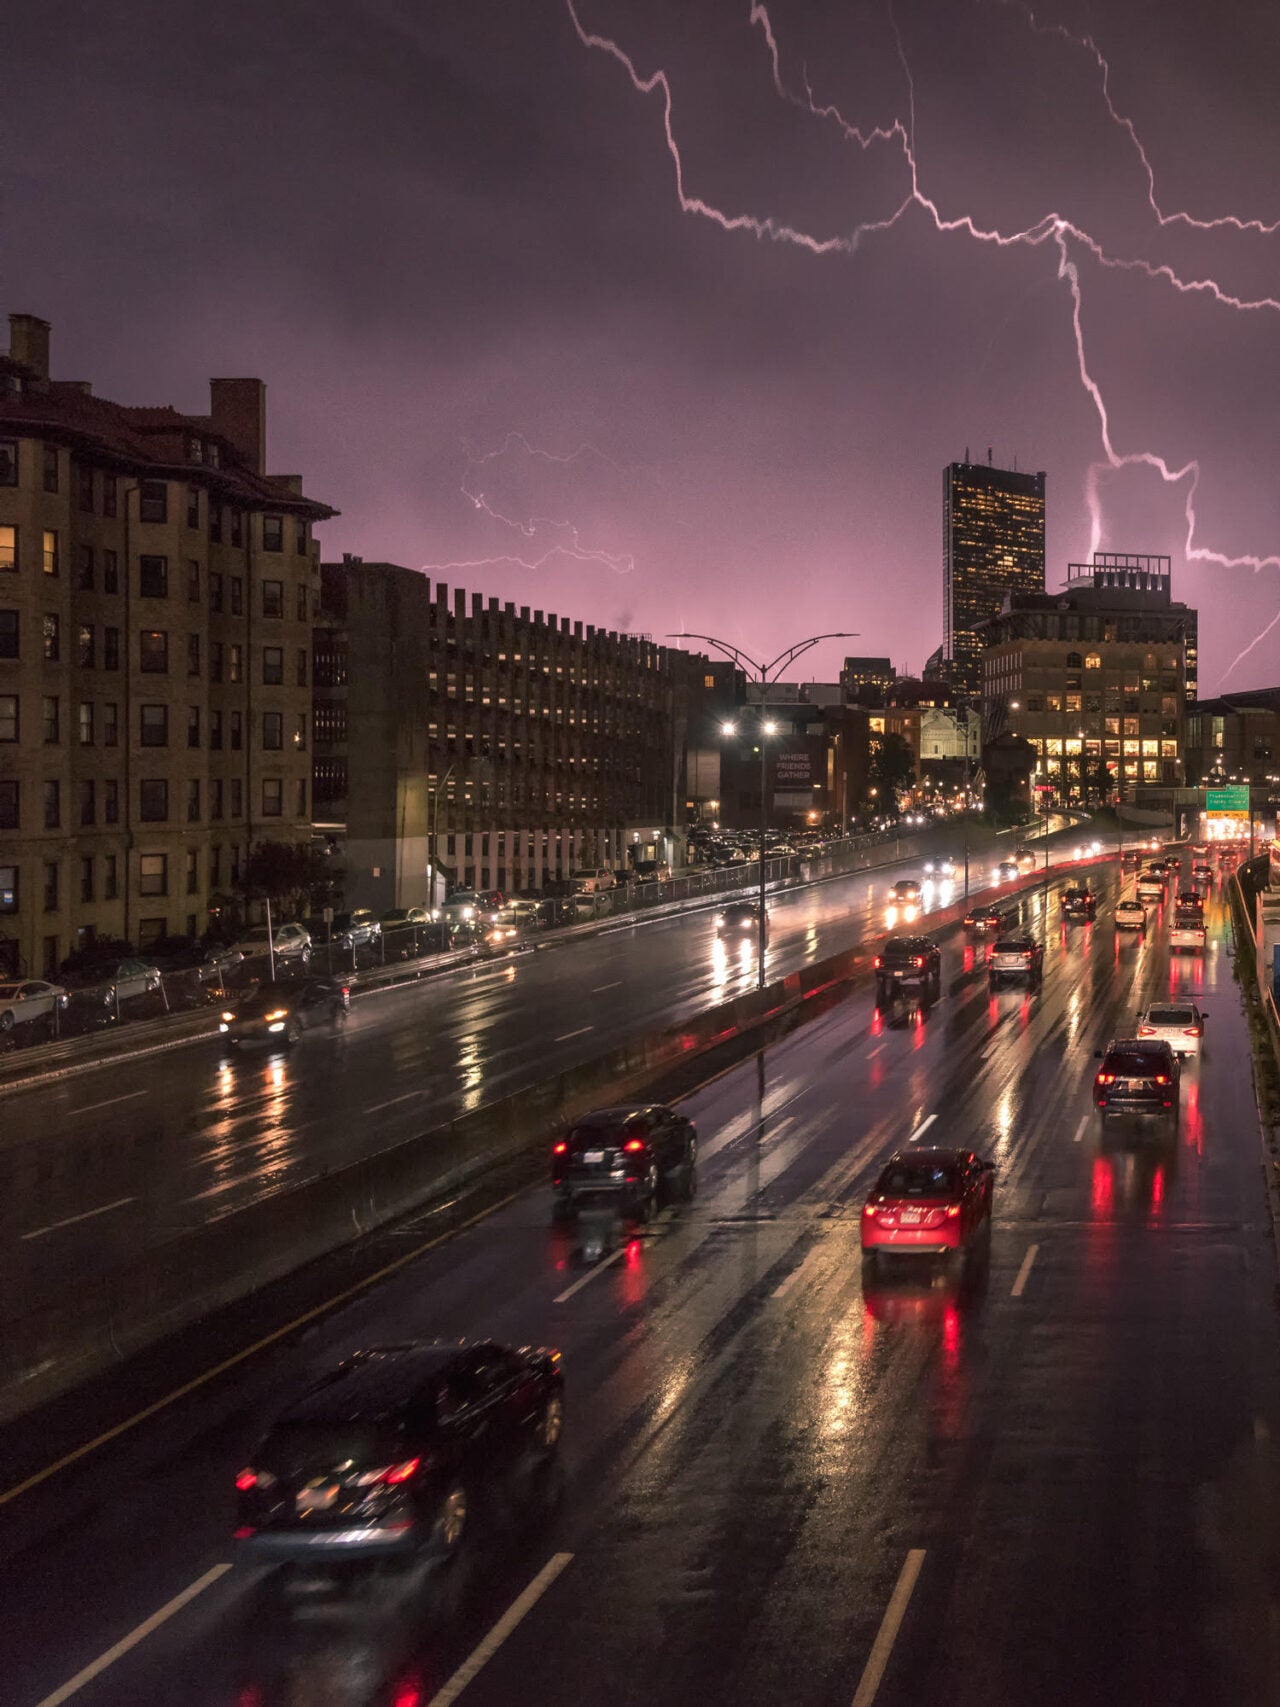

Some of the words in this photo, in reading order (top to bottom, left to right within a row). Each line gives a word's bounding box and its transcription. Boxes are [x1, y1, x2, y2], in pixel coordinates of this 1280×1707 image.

[779, 753, 809, 761] WHERE
[776, 762, 811, 770] FRIENDS
[777, 771, 810, 779] GATHER
